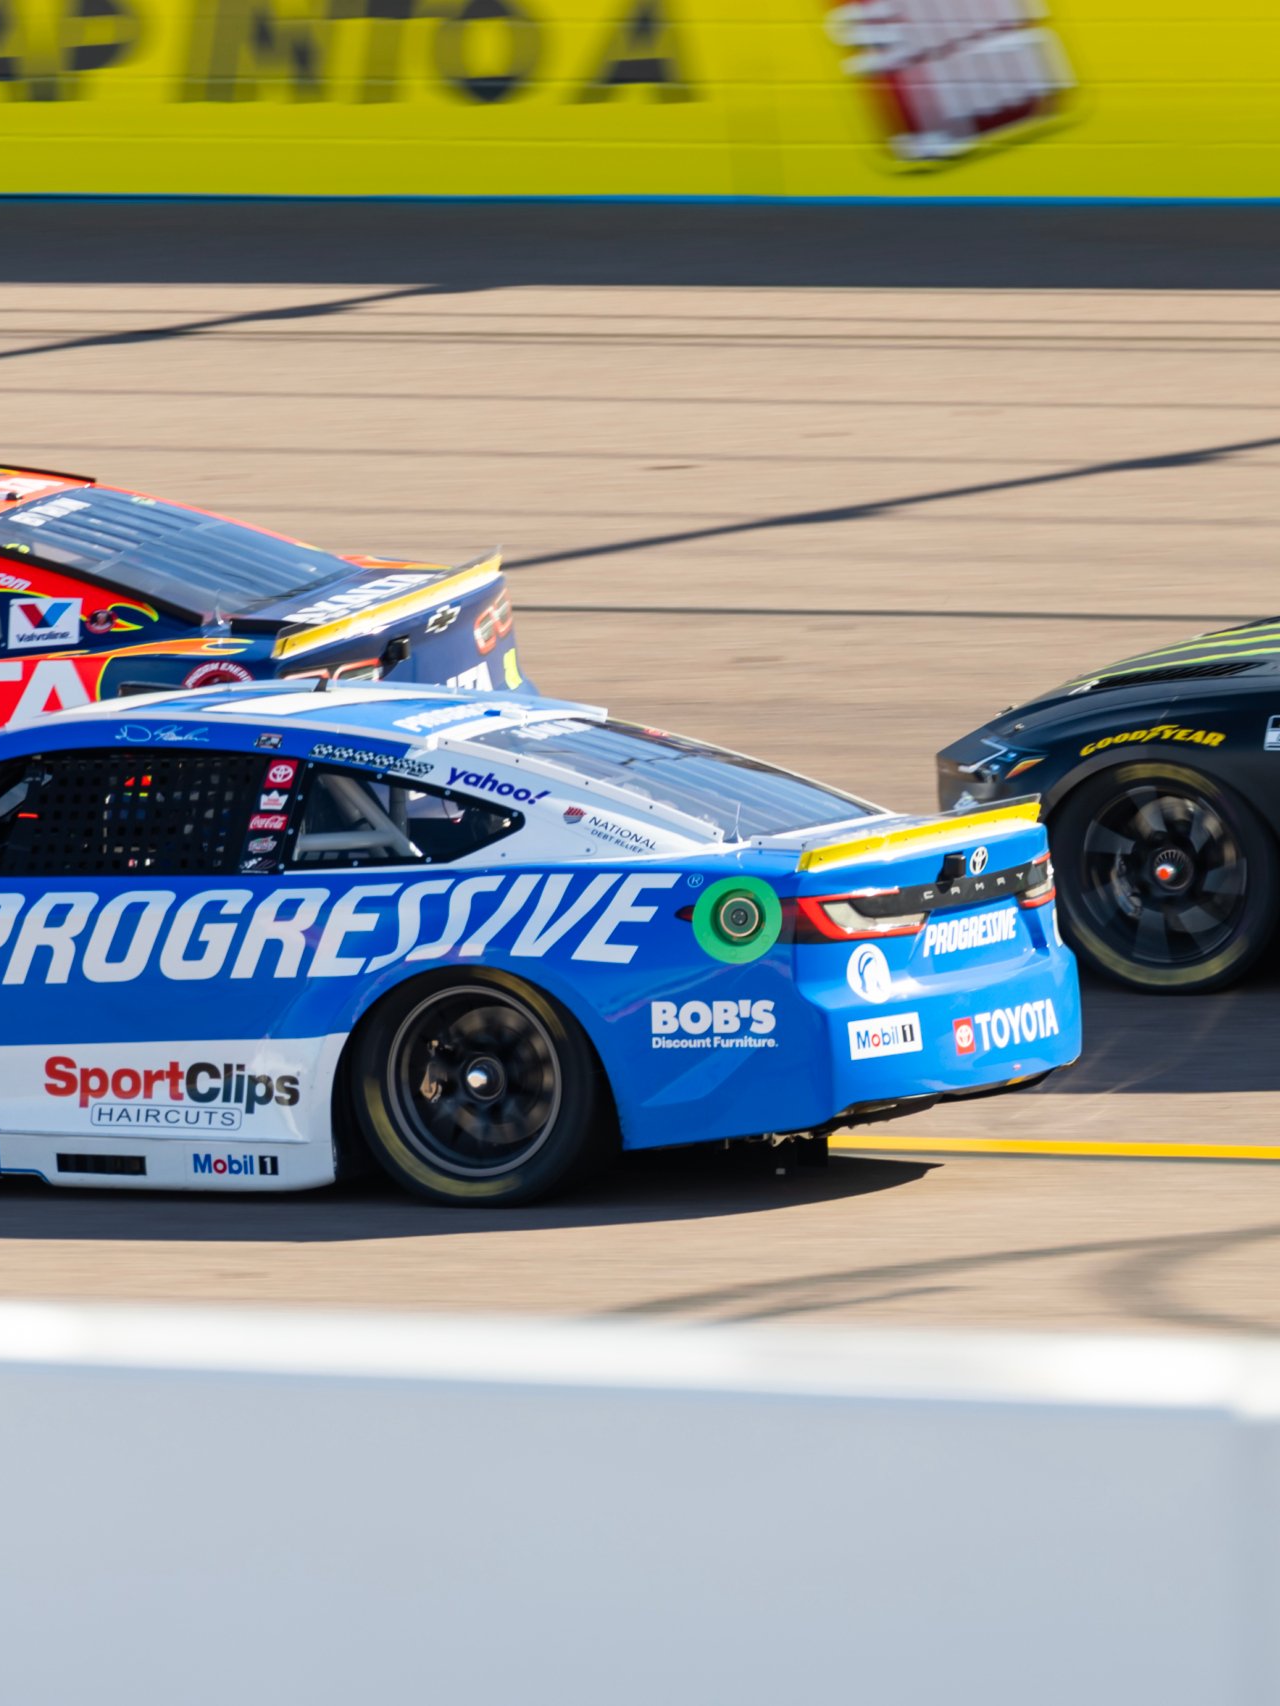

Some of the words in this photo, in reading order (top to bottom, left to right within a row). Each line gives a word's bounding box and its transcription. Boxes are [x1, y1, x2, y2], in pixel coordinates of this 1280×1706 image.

[562, 0, 705, 103] A
[16, 631, 71, 643] Valvoline
[1080, 724, 1226, 757] GOODYEAR
[446, 767, 551, 805] yahoo!
[588, 816, 656, 850] NATIONAL
[590, 828, 613, 842] DEBT
[923, 872, 1024, 900] CAMRY
[923, 906, 1019, 957] PROGRESSIVE
[651, 999, 777, 1035] BOB'S
[974, 998, 1060, 1051] TOYOTA
[652, 1036, 711, 1049] Discount
[856, 1022, 899, 1050] Mobil
[901, 1024, 915, 1043] 1
[97, 1107, 236, 1127] HAIRCUTS
[192, 1153, 255, 1176] Mobil
[259, 1155, 279, 1176] 1
